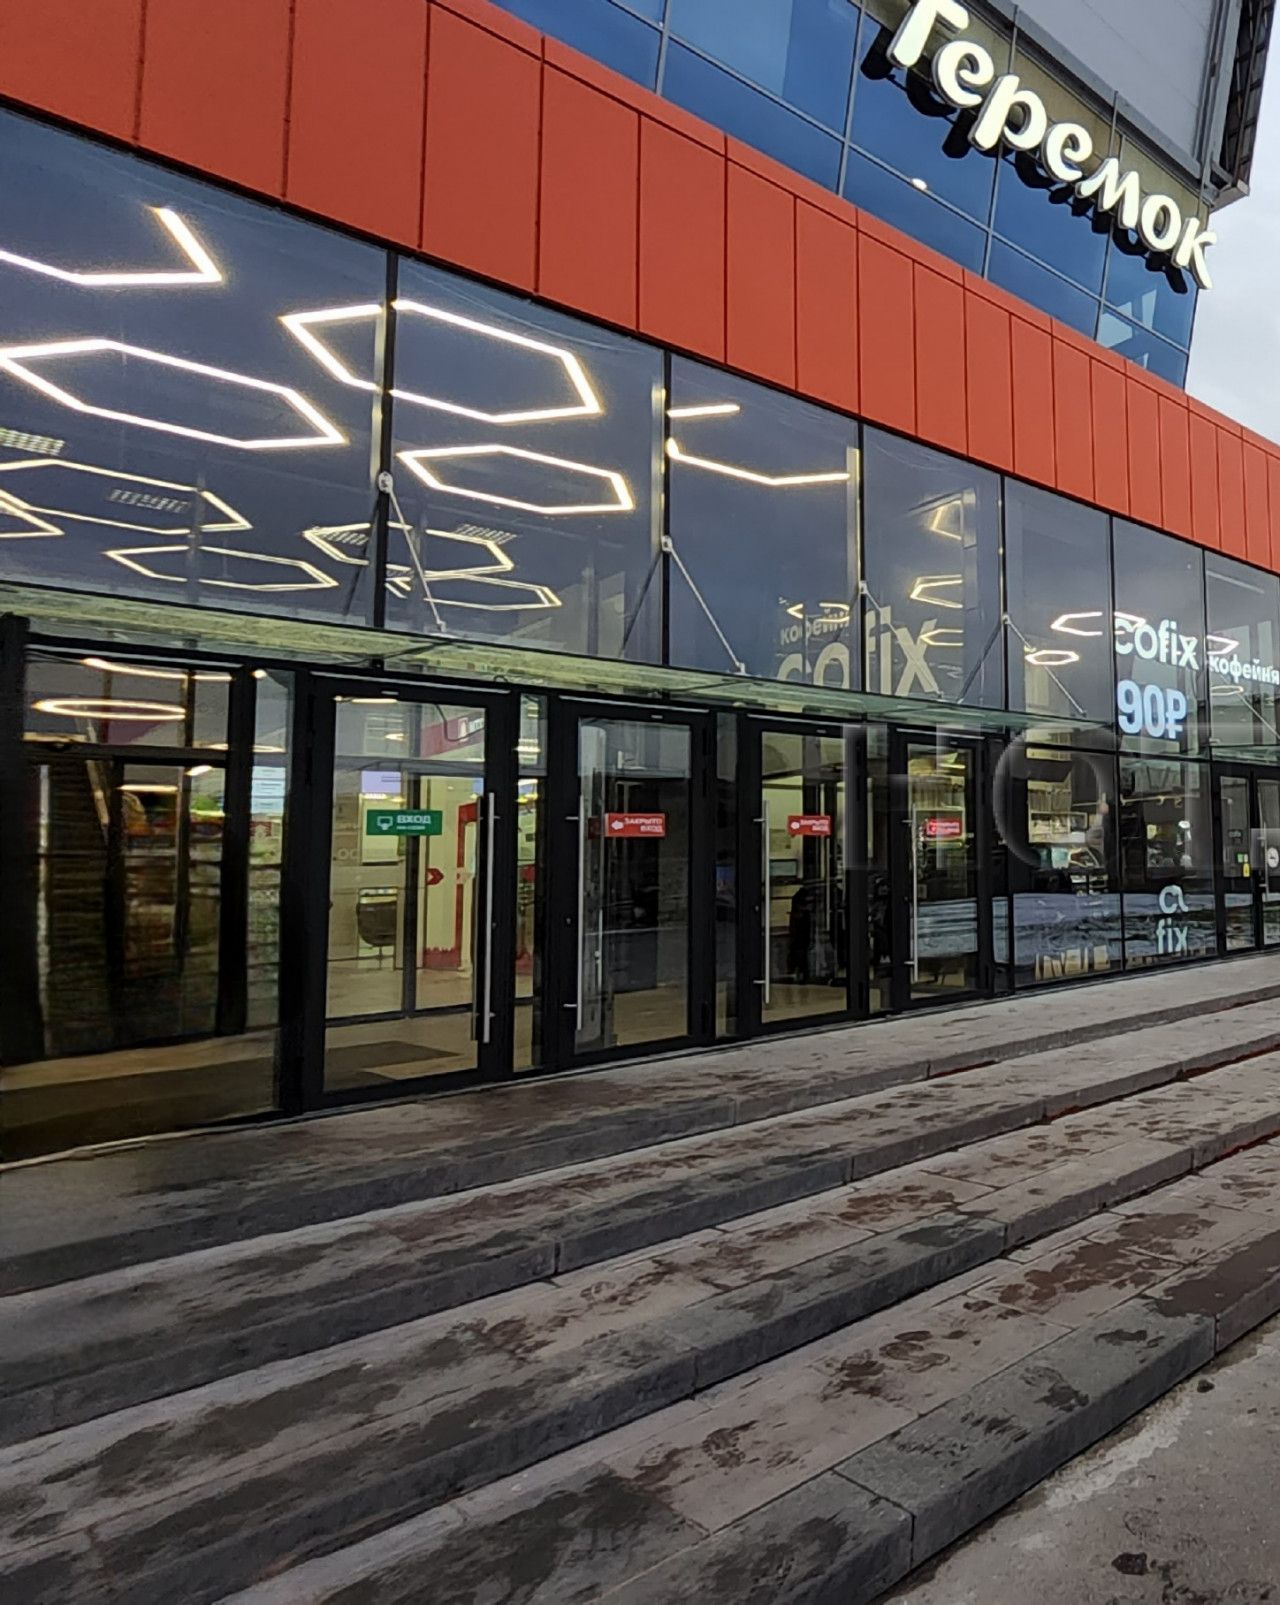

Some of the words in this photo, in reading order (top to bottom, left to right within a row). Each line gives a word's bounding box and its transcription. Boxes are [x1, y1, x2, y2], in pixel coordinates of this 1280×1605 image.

[1114, 618, 1200, 671] cofix
[1208, 653, 1280, 686] кофейня
[396, 814, 432, 825] ВХОД
[1156, 917, 1189, 956] fix
